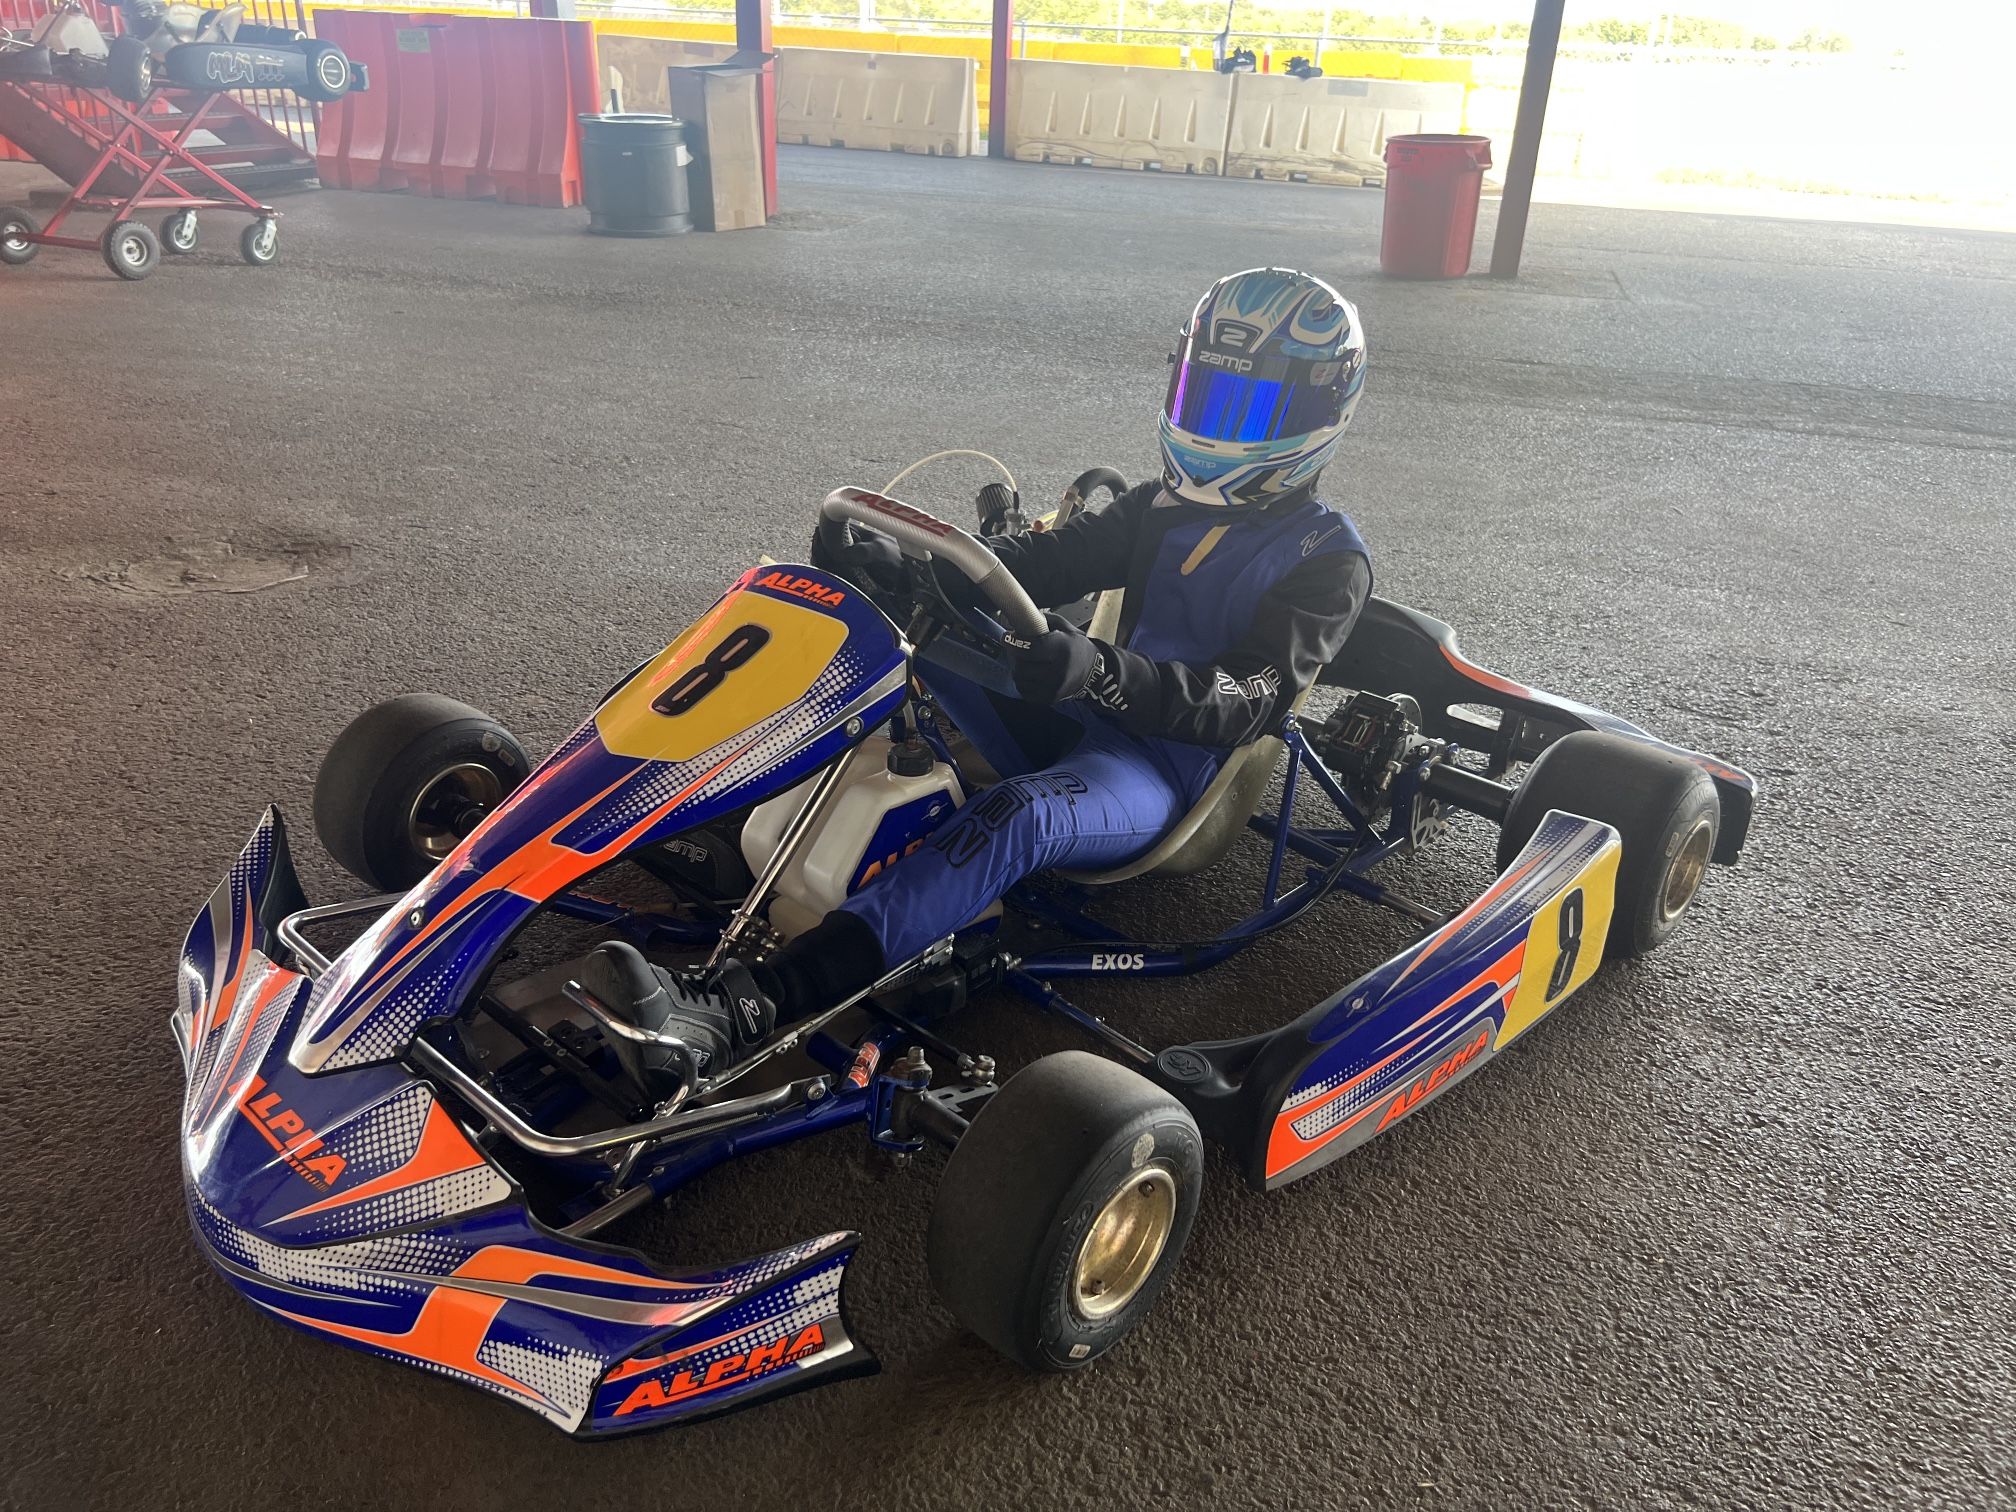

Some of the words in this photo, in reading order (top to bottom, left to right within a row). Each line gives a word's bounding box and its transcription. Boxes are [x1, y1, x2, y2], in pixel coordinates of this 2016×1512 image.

[1198, 350, 1253, 373] zamp
[753, 572, 846, 609] ALPHA
[651, 624, 771, 717] 8
[1091, 953, 1145, 970] EXOS
[1545, 887, 1584, 1003] 8
[1374, 1029, 1489, 1134] ALPHA
[227, 1073, 348, 1189] ALPHA
[612, 1322, 826, 1417] ALPHA
